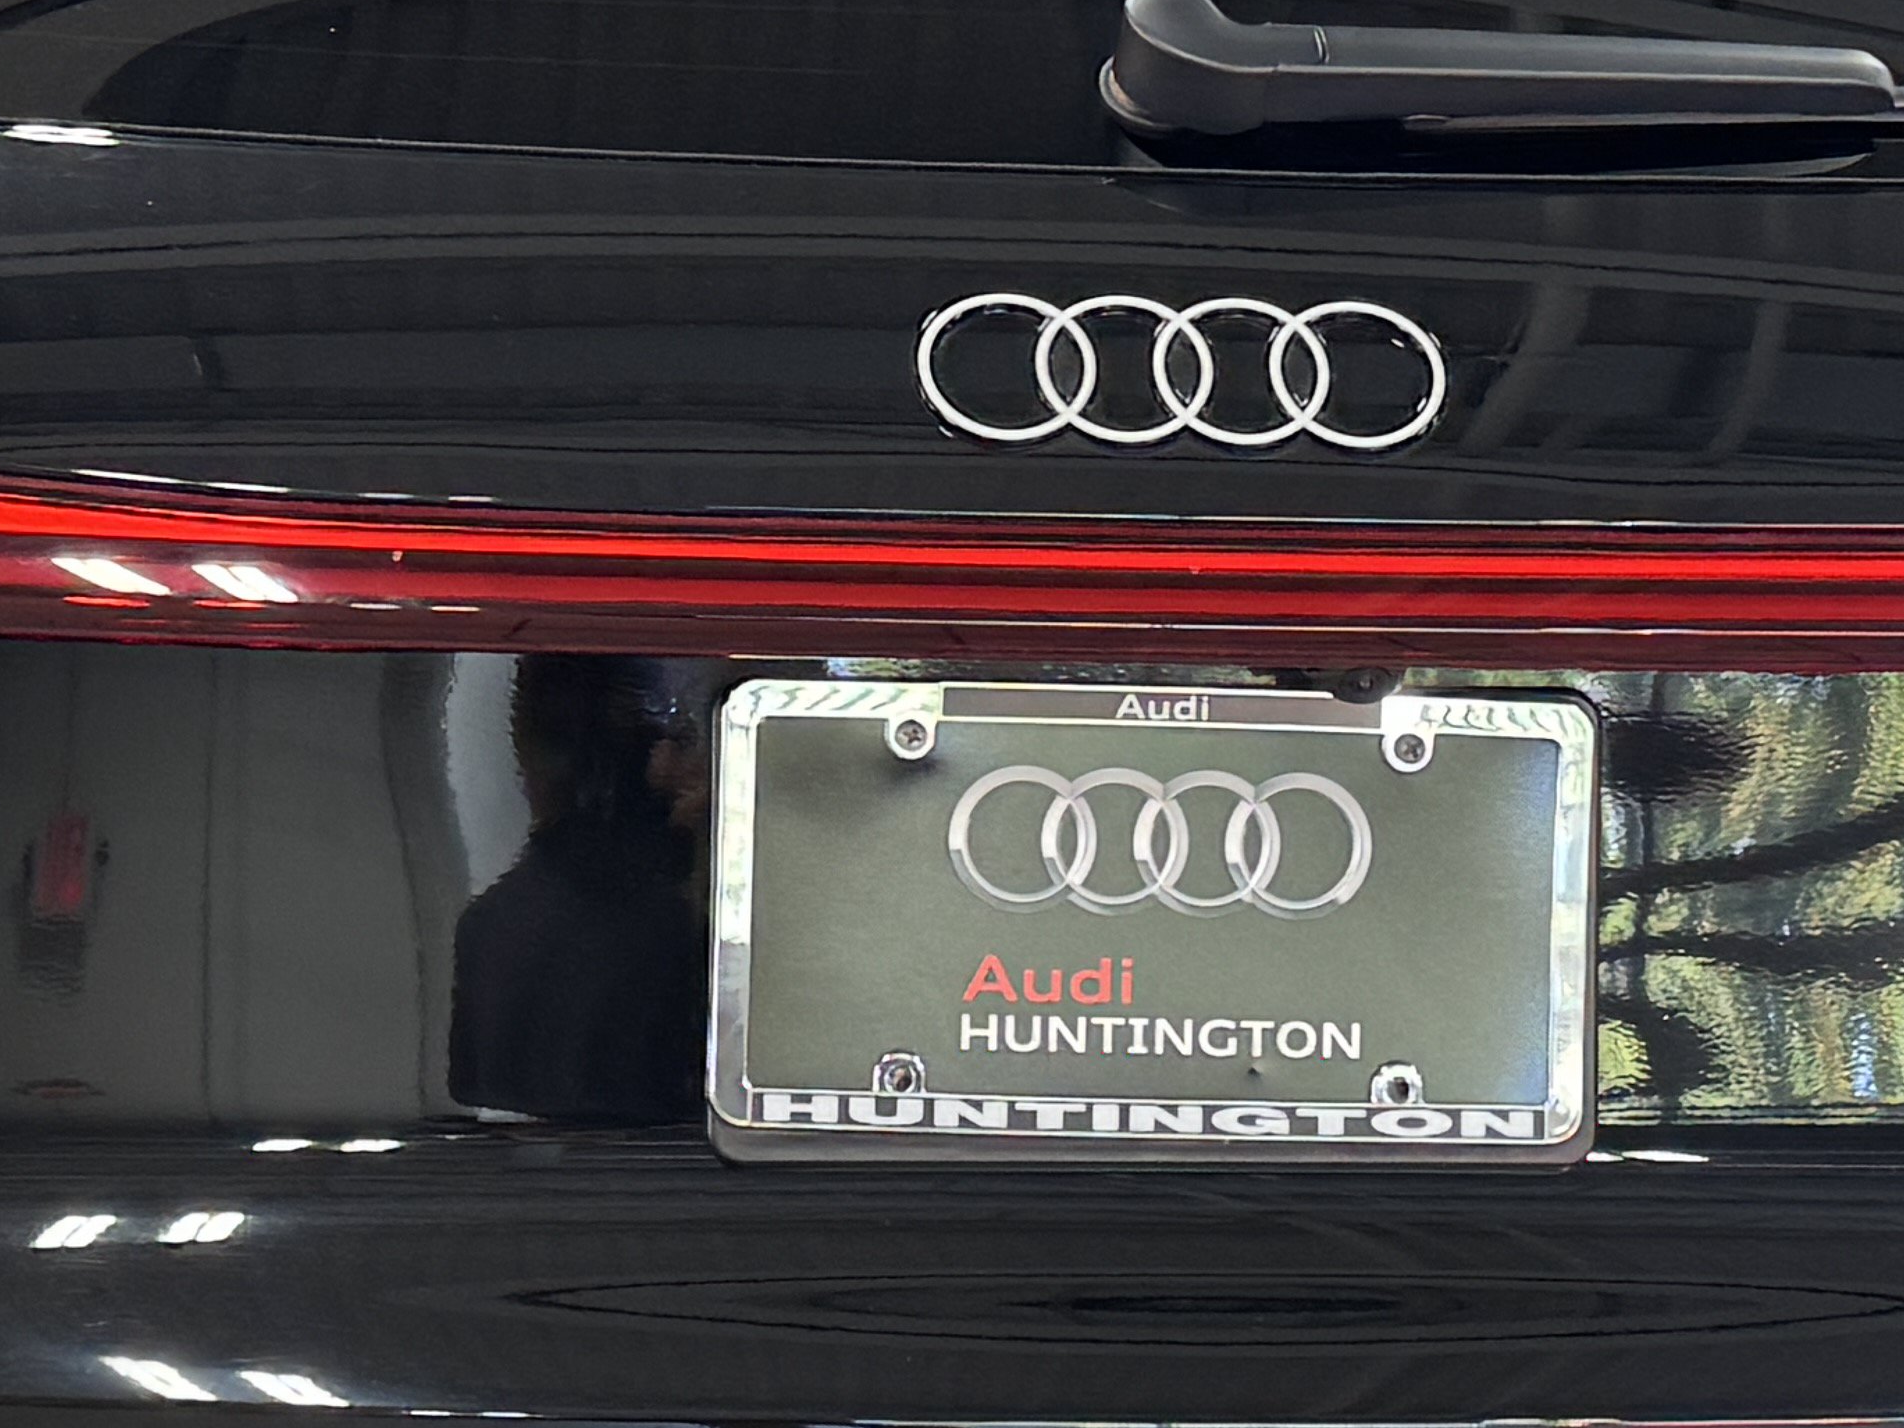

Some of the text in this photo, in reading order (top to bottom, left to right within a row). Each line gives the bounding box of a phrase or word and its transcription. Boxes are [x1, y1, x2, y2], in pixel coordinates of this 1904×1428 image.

[1115, 693, 1210, 722] Audi
[962, 954, 1135, 1005] Audi
[959, 1012, 1362, 1061] HUNTINGTON
[760, 1093, 1536, 1140] HUNTINGTON
